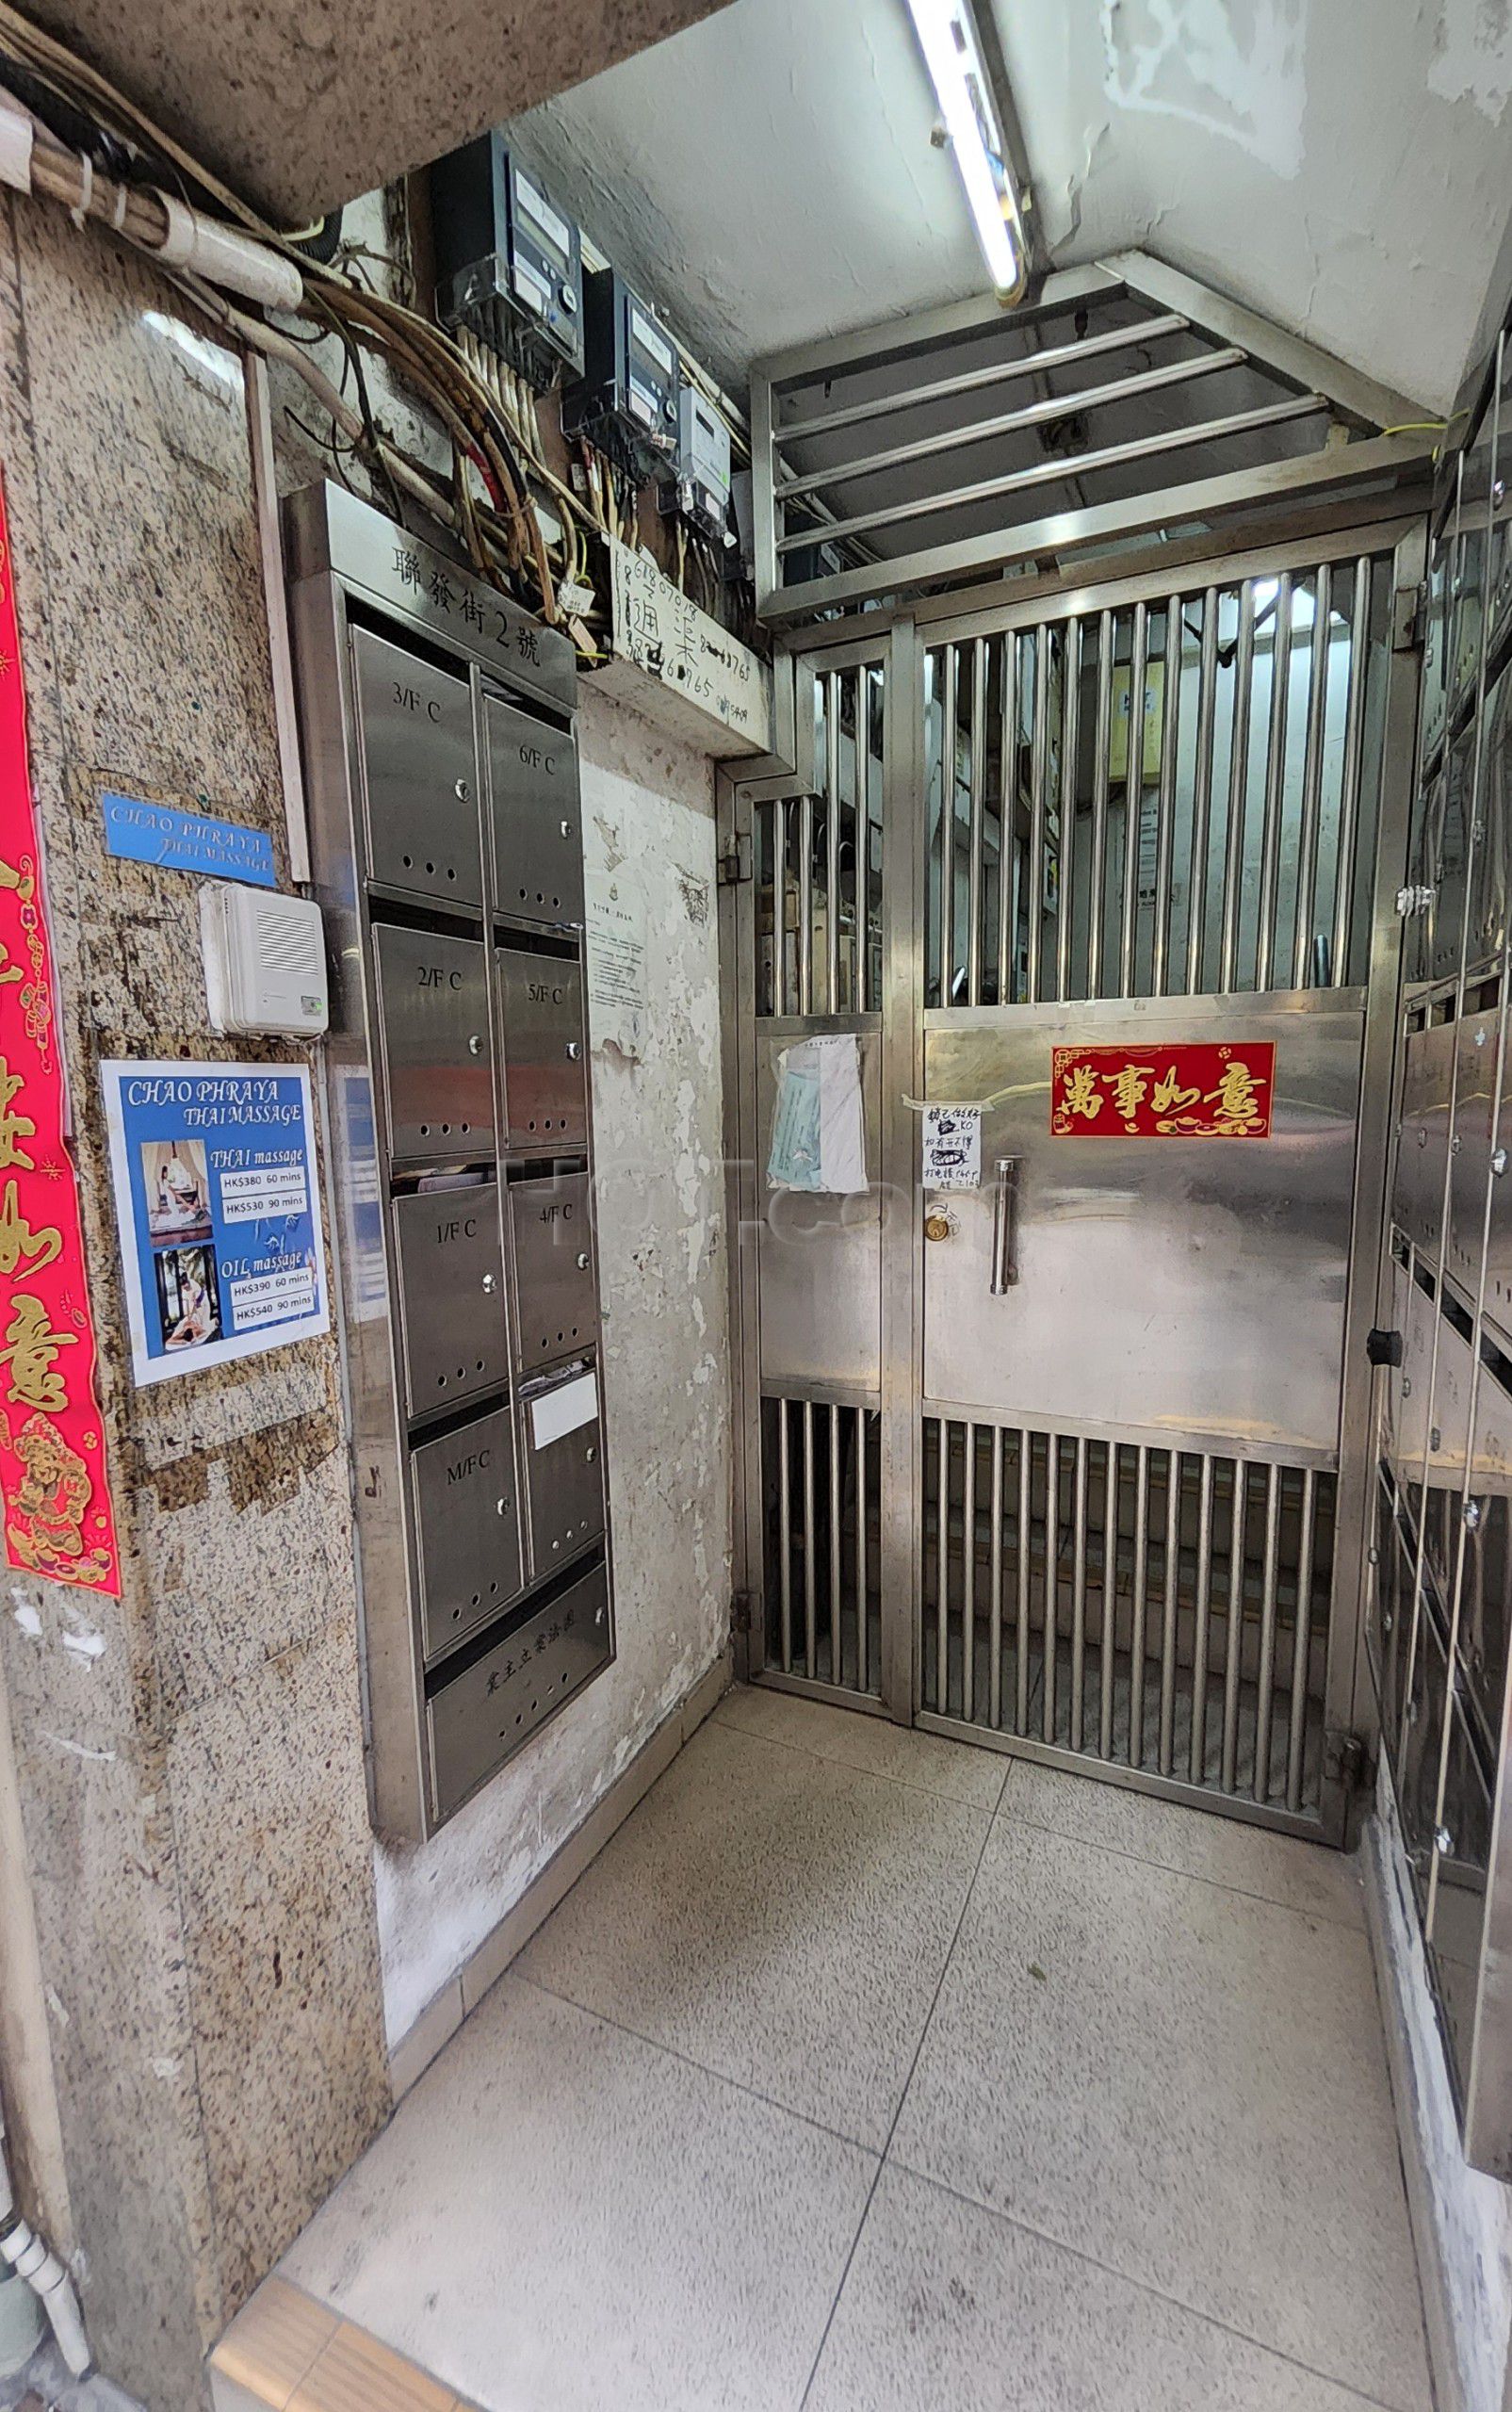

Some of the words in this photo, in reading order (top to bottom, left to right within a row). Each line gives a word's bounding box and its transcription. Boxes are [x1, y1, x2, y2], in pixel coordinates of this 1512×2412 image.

[392, 546, 541, 667] 聯發街2號
[392, 681, 421, 711] 3/F
[428, 701, 441, 723] C
[519, 744, 541, 769] 6/F
[545, 756, 555, 775] C
[110, 806, 173, 832] CHAO
[181, 821, 261, 854] PHRAYA
[417, 966, 444, 988] 2/F
[449, 971, 462, 992] C
[528, 983, 551, 1002] 5/F
[552, 986, 562, 1005] C
[128, 1080, 192, 1106] CHAO
[196, 1081, 279, 1105] PHRAYA
[1056, 1062, 1266, 1119] 萬事如意
[183, 1106, 225, 1127] THAI
[228, 1104, 301, 1127] MASSAGE
[210, 1149, 251, 1168] THAI
[254, 1149, 302, 1166] massage
[224, 1176, 262, 1188] HK$380
[267, 1174, 278, 1183] 60
[280, 1172, 301, 1182] mins
[226, 1201, 264, 1214] HK$530
[268, 1198, 280, 1208] 90
[282, 1197, 302, 1207] mins
[539, 1205, 560, 1224] 4/F
[562, 1203, 574, 1220] C
[436, 1221, 461, 1244] 1/F
[464, 1218, 478, 1239] C
[221, 1258, 250, 1278] OIL
[253, 1251, 301, 1271] massage
[234, 1280, 270, 1296] HK$390
[275, 1278, 286, 1287] 60
[288, 1273, 309, 1284] mins
[236, 1304, 272, 1320] HK$540
[277, 1300, 288, 1311] 90
[290, 1296, 311, 1307] mins
[447, 1454, 477, 1486] M/F
[477, 1449, 491, 1469] C
